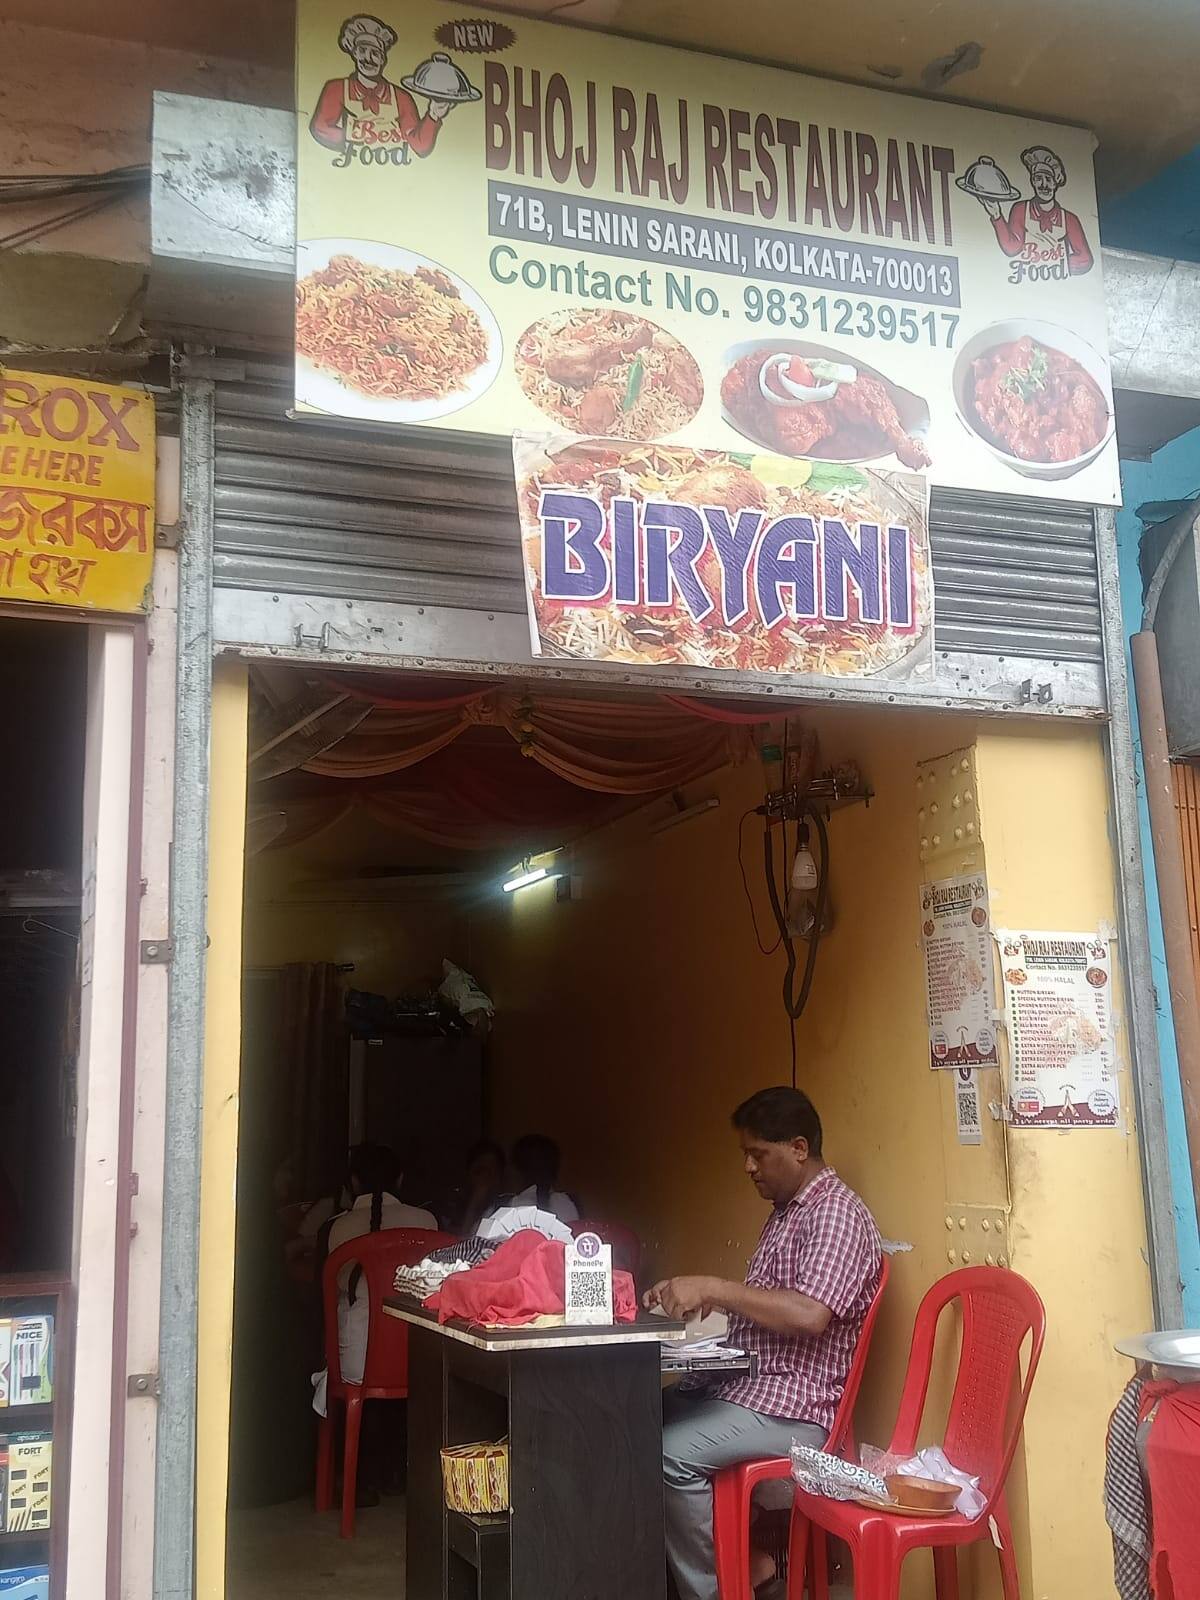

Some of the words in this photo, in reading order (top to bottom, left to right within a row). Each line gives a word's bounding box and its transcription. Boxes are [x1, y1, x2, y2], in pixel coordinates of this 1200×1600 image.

[453, 24, 495, 49] NEW
[351, 118, 409, 145] Best
[331, 142, 412, 169] Food
[484, 60, 598, 189] BHOJ
[612, 86, 689, 205] RAJ
[703, 103, 956, 247] RESTAURANT
[495, 192, 554, 242] 71B,
[562, 205, 639, 249] LENIN
[646, 218, 748, 273] SARANI,
[754, 237, 953, 297] KOLKATA-700013
[1022, 242, 1065, 263] Best
[1007, 260, 1069, 285] Food
[488, 245, 653, 307] Contact
[665, 272, 731, 319] No.
[743, 285, 961, 349] 9831239517
[21, 447, 105, 487] HERE
[538, 490, 913, 629] BIRYANI
[1051, 941, 1087, 957] RESTAURANT
[1054, 976, 1076, 984] HALAL
[573, 1259, 604, 1267] PhonePe
[16, 1331, 43, 1340] NICE
[18, 1446, 43, 1456] FORT
[33, 1466, 49, 1480] FORT
[11, 1483, 27, 1497] FORT
[32, 1495, 48, 1508] FORT
